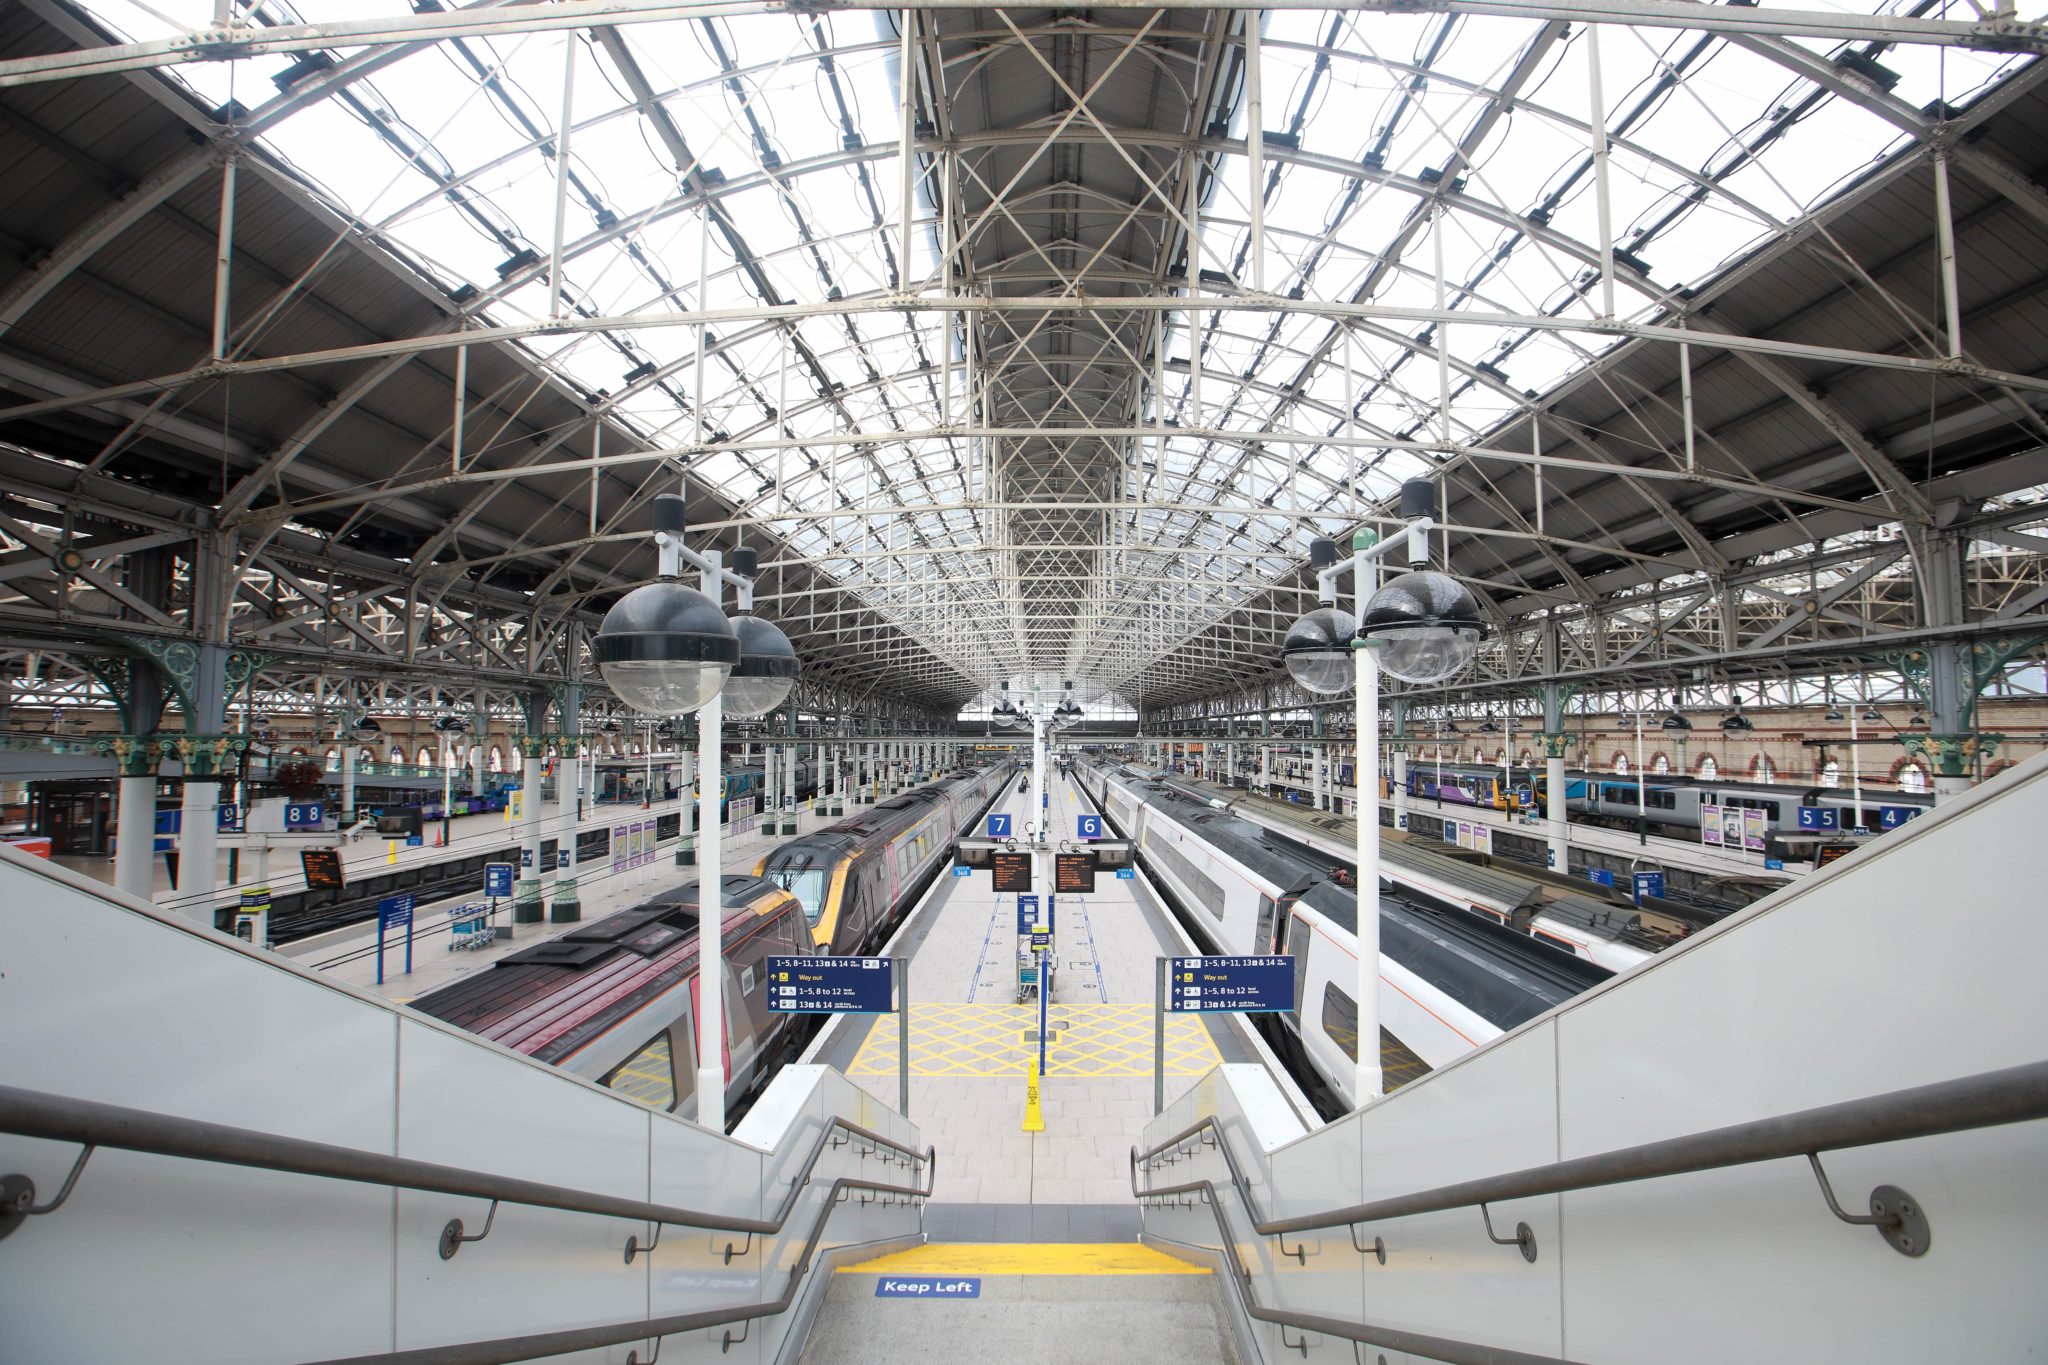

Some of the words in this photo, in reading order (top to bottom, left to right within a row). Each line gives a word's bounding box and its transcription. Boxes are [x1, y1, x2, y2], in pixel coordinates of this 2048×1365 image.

[224, 808, 234, 822] 9
[290, 808, 300, 822] 8
[310, 806, 318, 820] 8
[1803, 810, 1812, 824] 5
[1823, 812, 1832, 825] 5
[1886, 810, 1896, 824] 4
[994, 818, 1006, 832] 7
[1084, 818, 1095, 832] 6
[884, 1282, 930, 1293] Keep
[935, 1282, 973, 1292] Left
